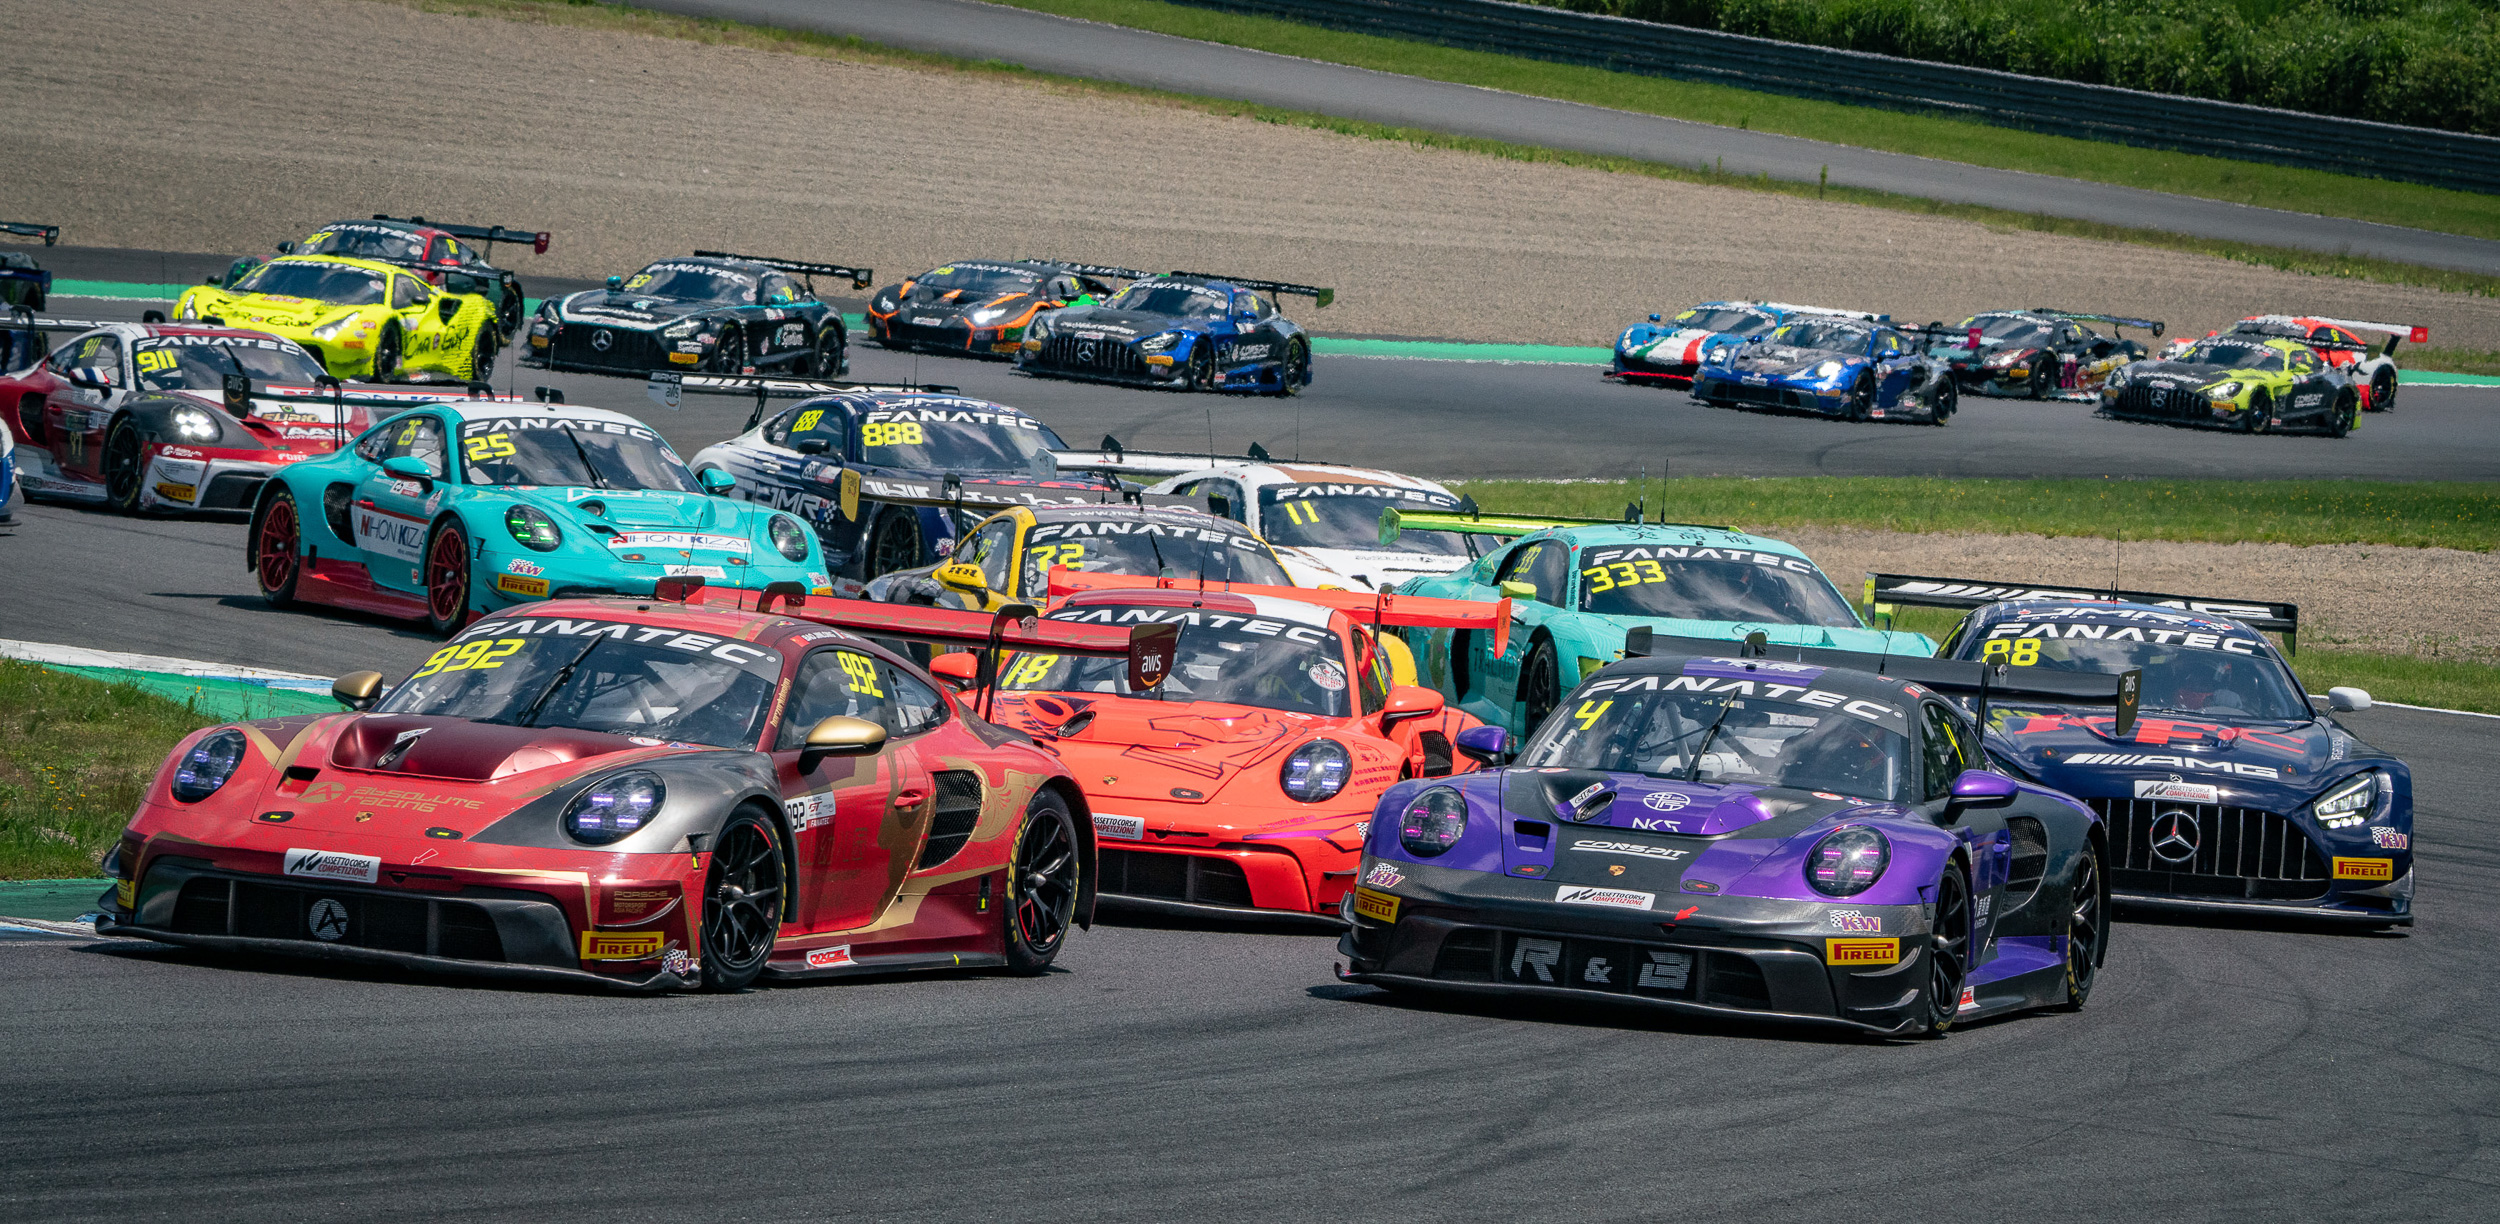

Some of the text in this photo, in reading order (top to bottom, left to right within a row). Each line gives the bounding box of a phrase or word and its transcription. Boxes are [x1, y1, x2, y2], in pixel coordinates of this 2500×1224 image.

[137, 336, 300, 355] FANATEC
[137, 350, 177, 372] 911
[227, 375, 244, 391] aws
[464, 417, 659, 440] FANATEC
[792, 409, 824, 432] 888
[866, 411, 1040, 430] FANATEC
[397, 420, 422, 445] 25
[862, 422, 923, 446] 888
[464, 434, 516, 461] 25
[1276, 485, 1455, 507] FANATEC
[1285, 501, 1320, 525] 11
[360, 514, 398, 543] NIHON
[613, 534, 683, 544] NIHON
[1031, 522, 1258, 551] FANATEC
[1031, 544, 1085, 571] 72
[1593, 548, 1811, 574] FANATEC
[501, 575, 545, 597] PIRELLI
[1582, 560, 1667, 594] 333
[1046, 609, 1321, 646] FANATEC
[1988, 622, 2257, 655] FANATEC
[455, 617, 768, 666] FANATEC
[1981, 638, 2042, 667] 88
[414, 639, 525, 678] 992
[1141, 653, 1162, 673] aws
[836, 651, 885, 699] 992
[1001, 654, 1059, 687] 18
[2124, 675, 2137, 692] aws
[1578, 676, 1892, 721] FANATEC
[1575, 699, 1614, 731] 4
[2165, 790, 2210, 799] COMPETIZIONE
[1092, 823, 1137, 835] OMPETIZIONE
[1116, 819, 1138, 828] CORSA
[1573, 839, 1690, 858] CONSPIT
[2380, 833, 2408, 849] KW
[317, 863, 369, 877] COMPETIZIONE
[322, 855, 371, 869] ASSETTO CORSA
[2338, 861, 2388, 876] PIRELLI
[1367, 870, 1405, 888] KW
[614, 890, 668, 898] PORSCHE
[1356, 891, 1394, 917] PIRELLI
[1591, 896, 1644, 907] COMPETIZIONE
[1597, 890, 1646, 901] ASSETTO CORSA
[1838, 913, 1882, 932] KW
[589, 936, 659, 955] PIRELLI
[1833, 942, 1895, 961] PIRELLI
[810, 949, 849, 965] DIXCEL
[1510, 937, 1694, 990] R & B
